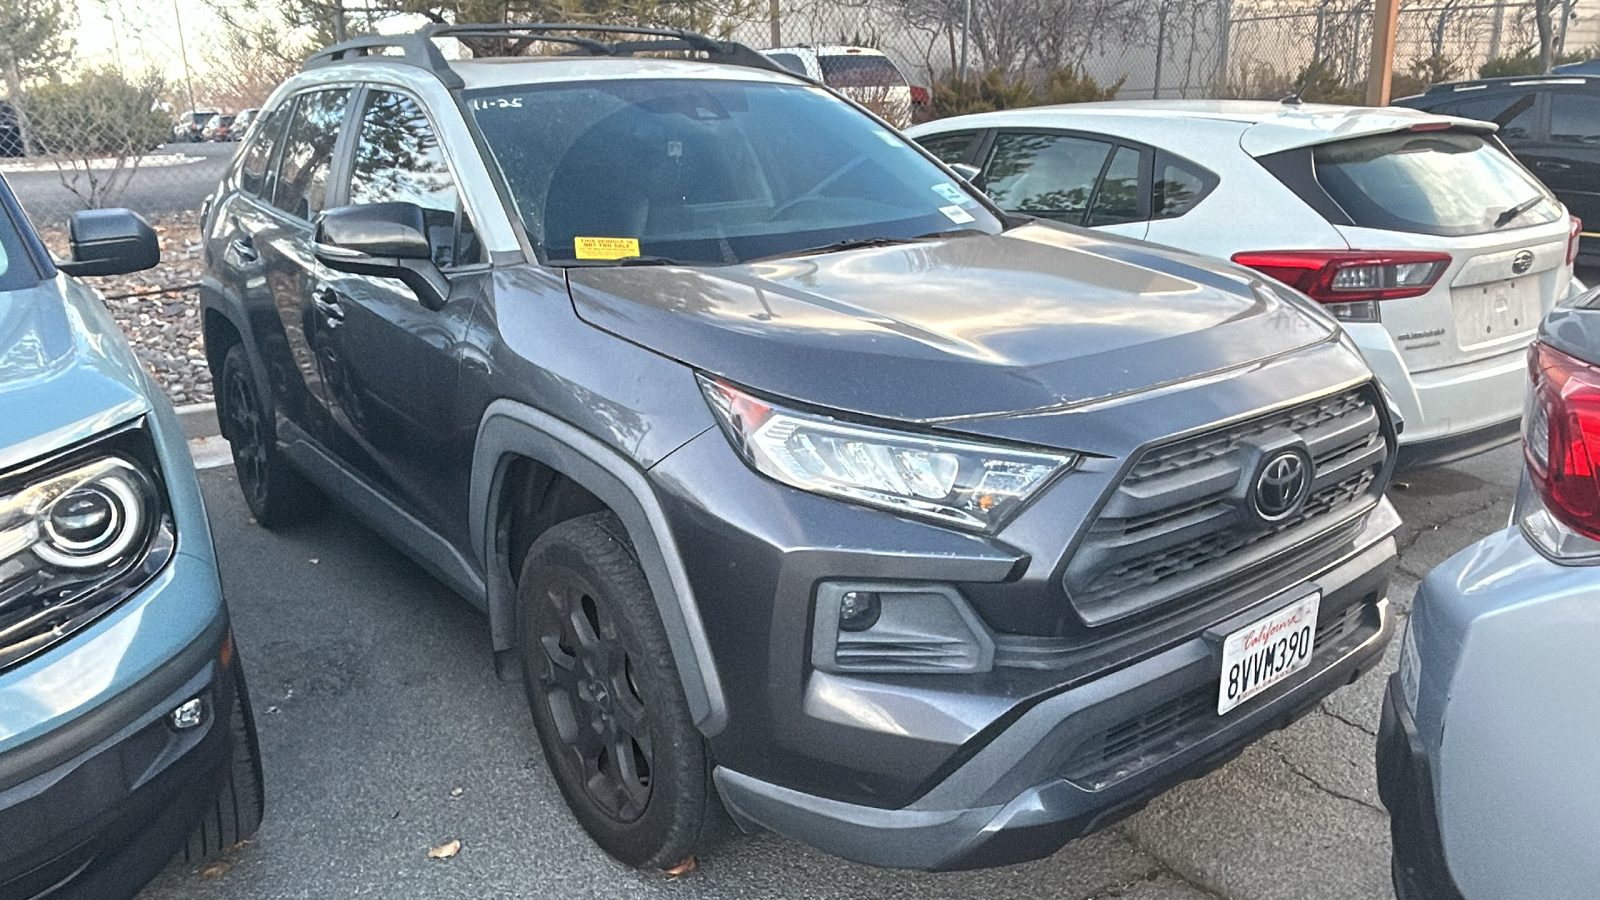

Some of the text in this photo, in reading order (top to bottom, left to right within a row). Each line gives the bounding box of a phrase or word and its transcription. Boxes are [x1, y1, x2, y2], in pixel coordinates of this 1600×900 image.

[474, 98, 522, 110] 11-25
[1244, 614, 1300, 650] California
[1228, 626, 1310, 699] 8VVM390
